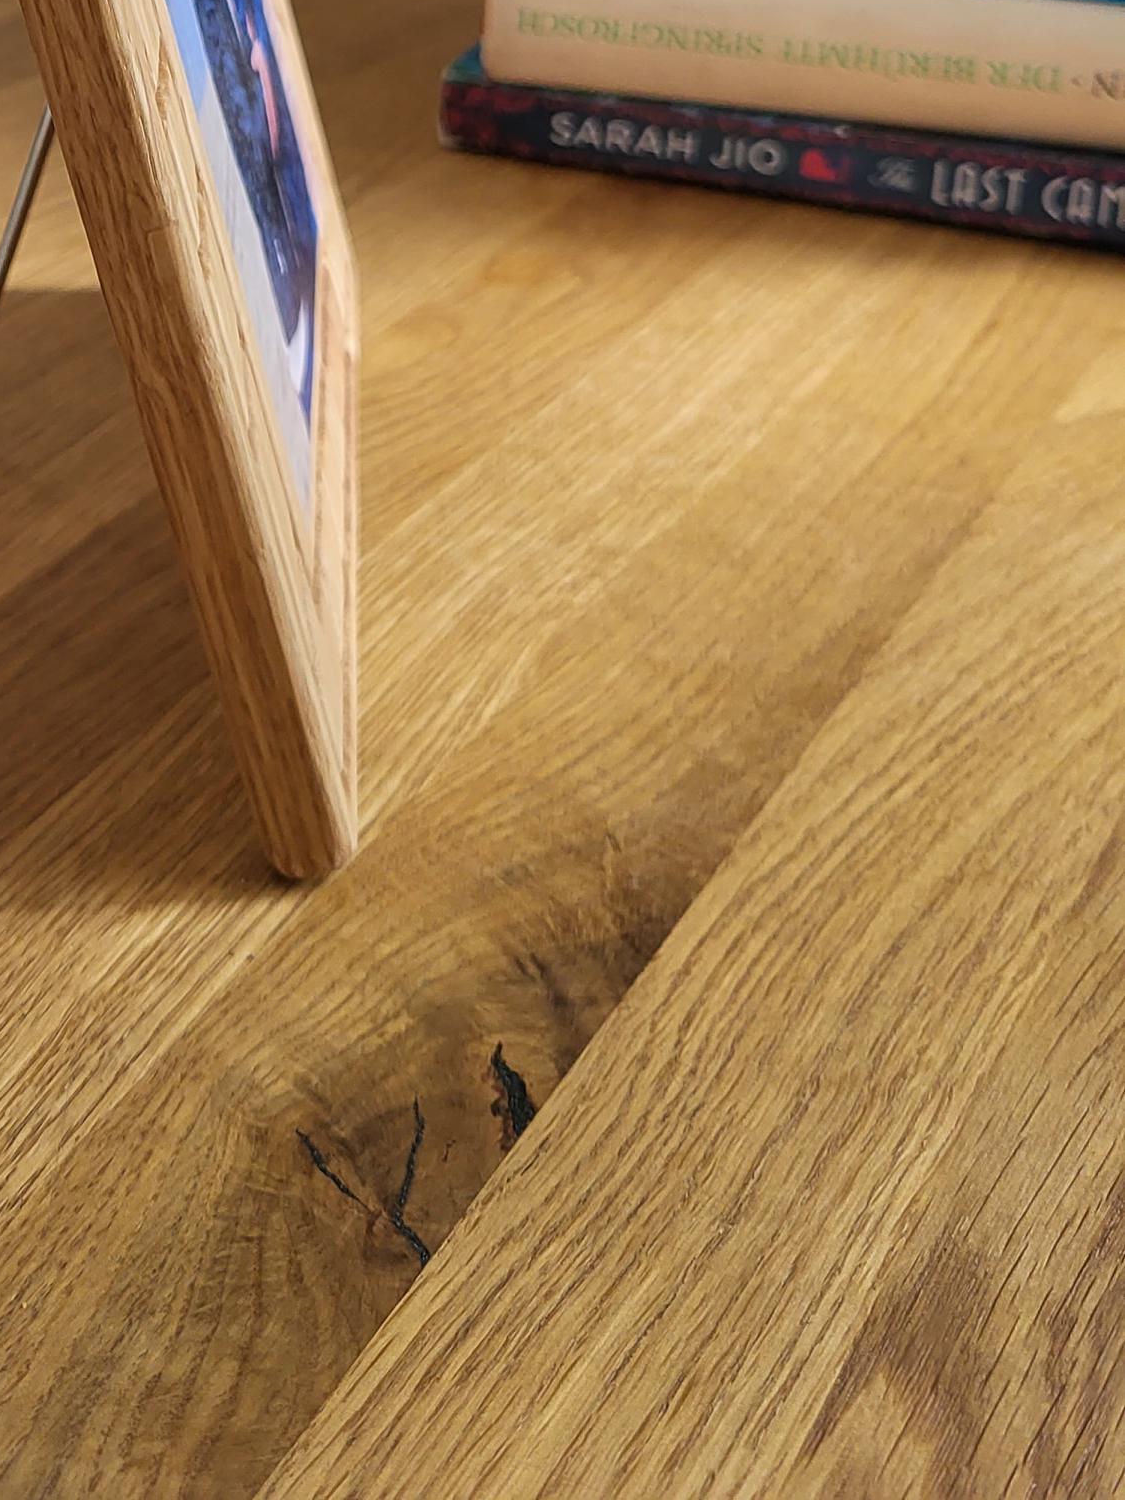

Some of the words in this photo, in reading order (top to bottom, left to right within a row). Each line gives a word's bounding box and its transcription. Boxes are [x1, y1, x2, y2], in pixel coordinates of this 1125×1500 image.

[549, 111, 698, 164] SARAH
[708, 135, 789, 176] JIO
[931, 157, 1029, 215] LAST
